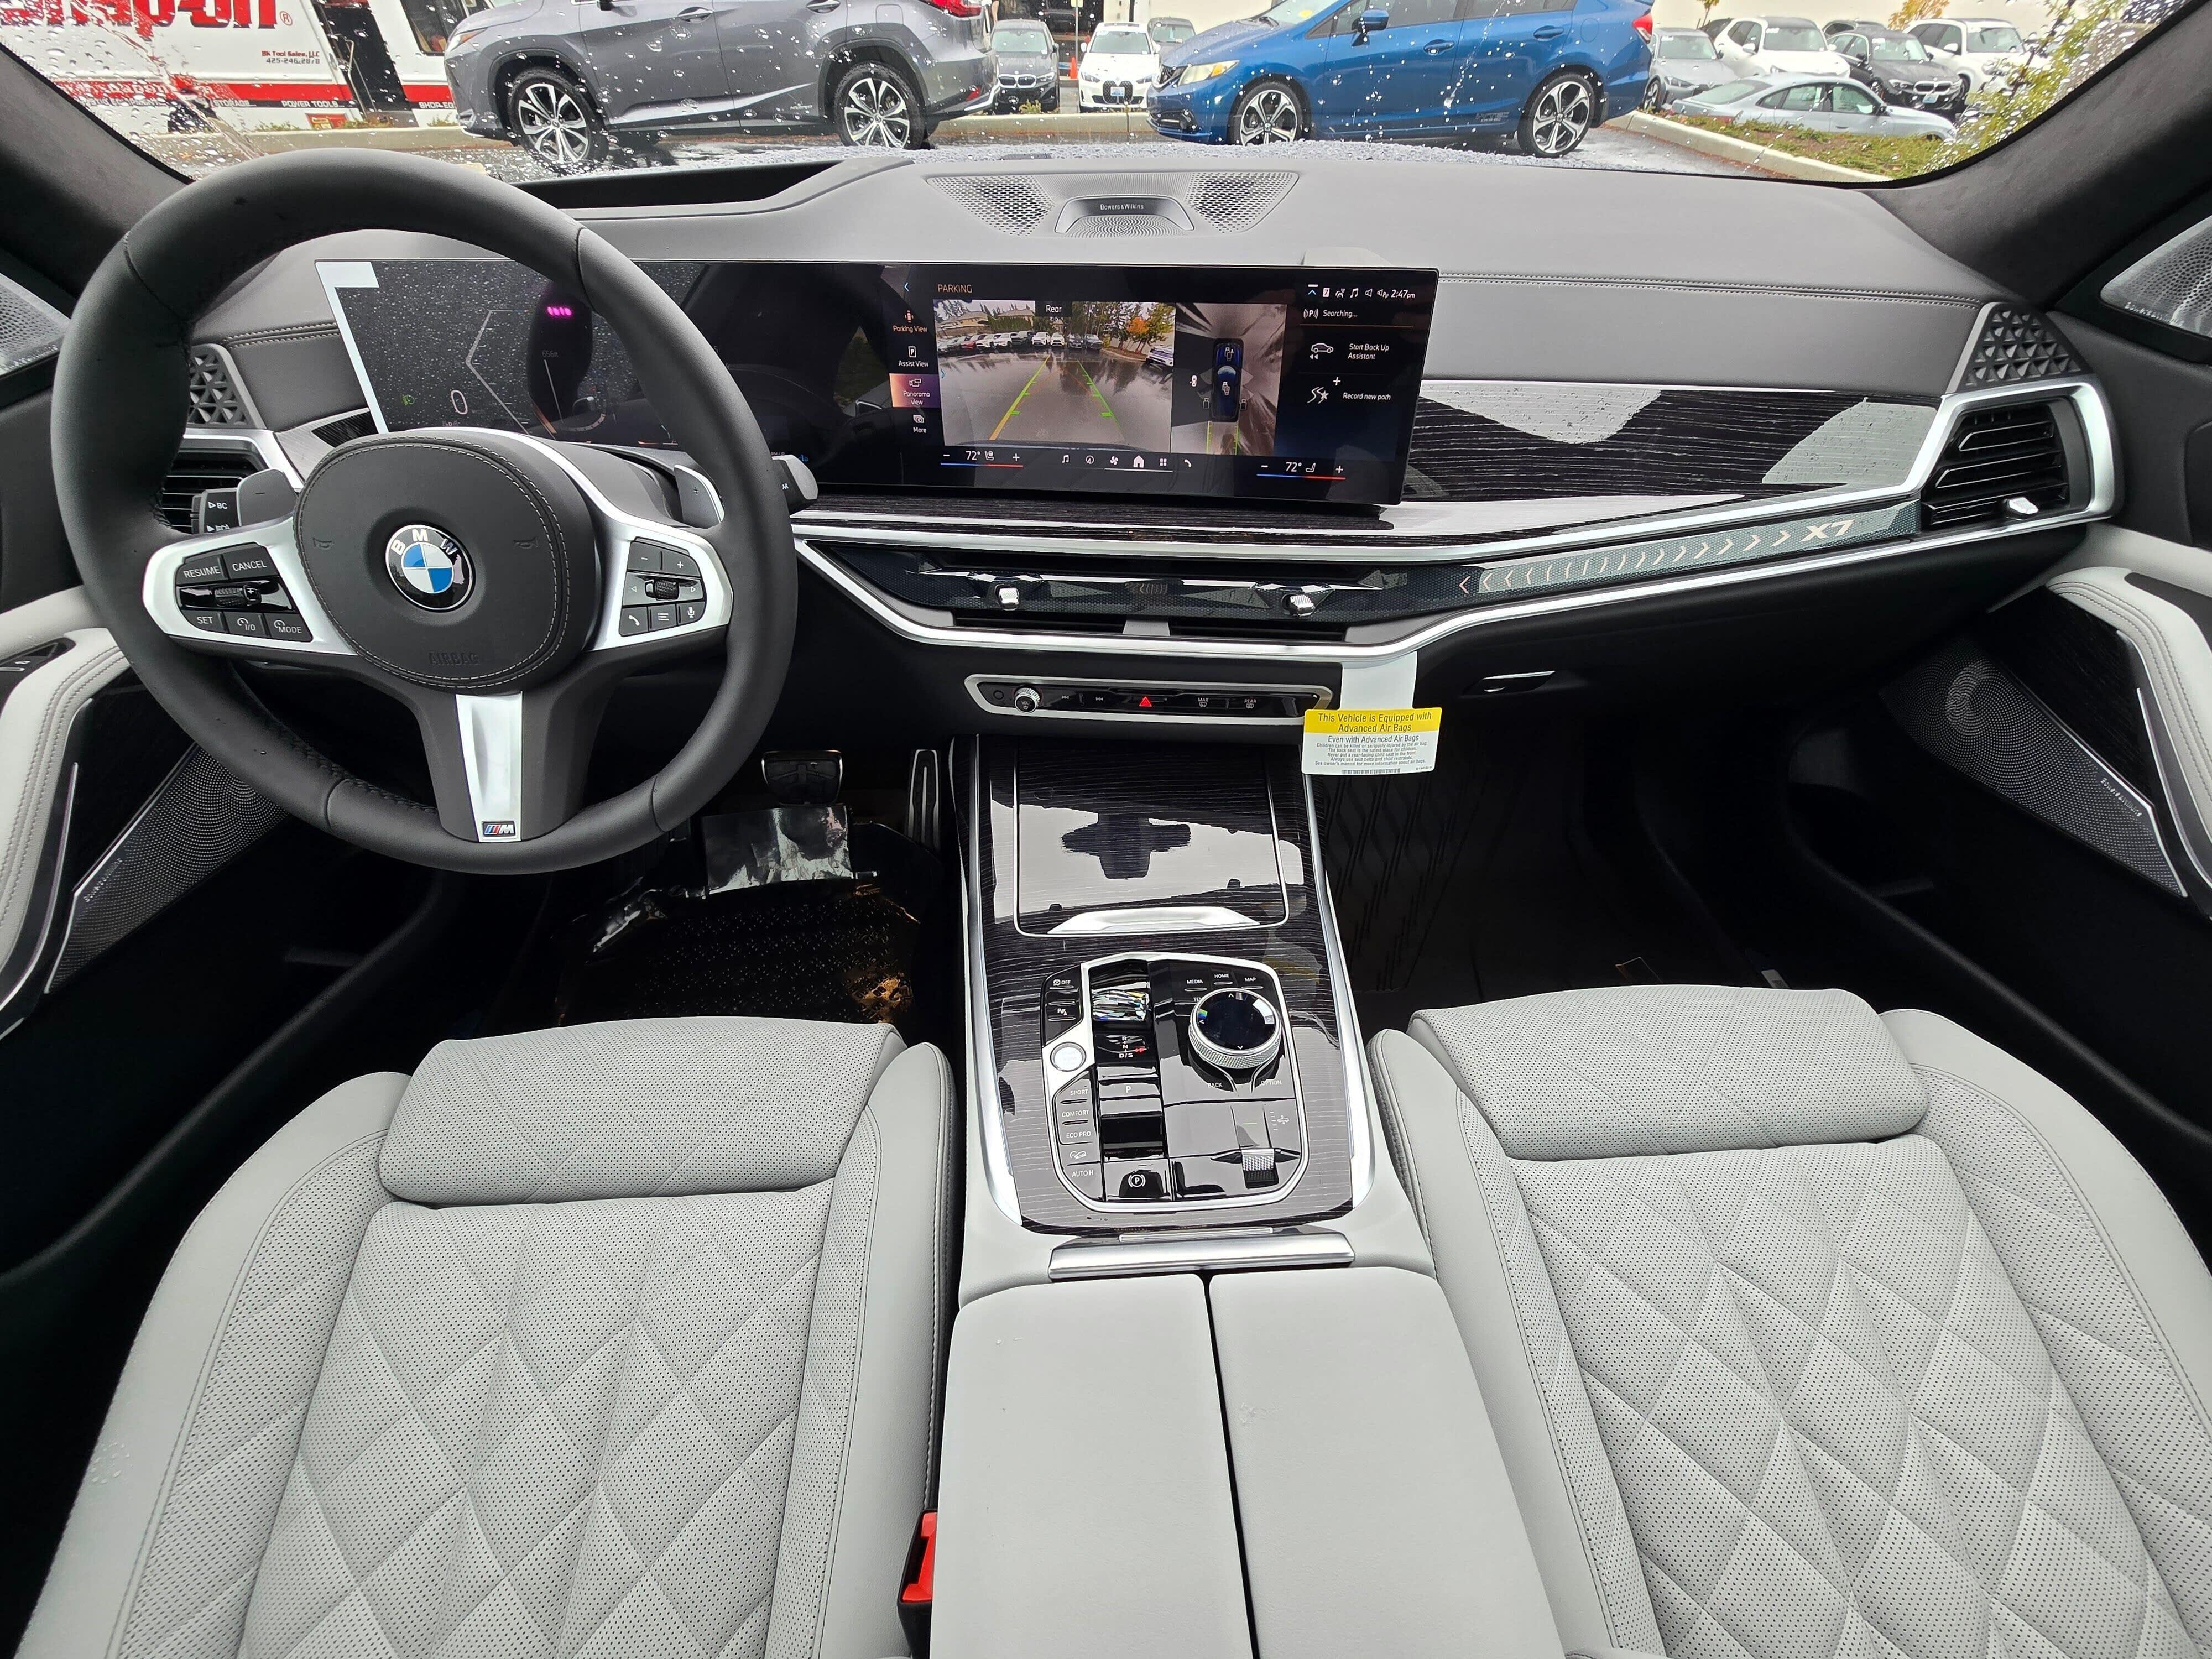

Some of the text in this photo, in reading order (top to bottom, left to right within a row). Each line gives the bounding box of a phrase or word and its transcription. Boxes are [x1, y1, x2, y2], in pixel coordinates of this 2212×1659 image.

[937, 284, 973, 294] PARKING
[1046, 305, 1062, 313] Rear
[1323, 310, 1358, 319] Searching...
[893, 325, 912, 333] Parking
[1381, 344, 1390, 352] Up
[1378, 393, 1391, 401] path
[1799, 519, 1855, 542] X7
[232, 560, 268, 572] CANCEL
[183, 566, 221, 578] RESUME
[197, 616, 213, 624] SET
[1318, 712, 1432, 723] This Vehicle is Equipped with
[1338, 723, 1412, 733] Advanced Air Bags
[1404, 734, 1420, 743] Bags
